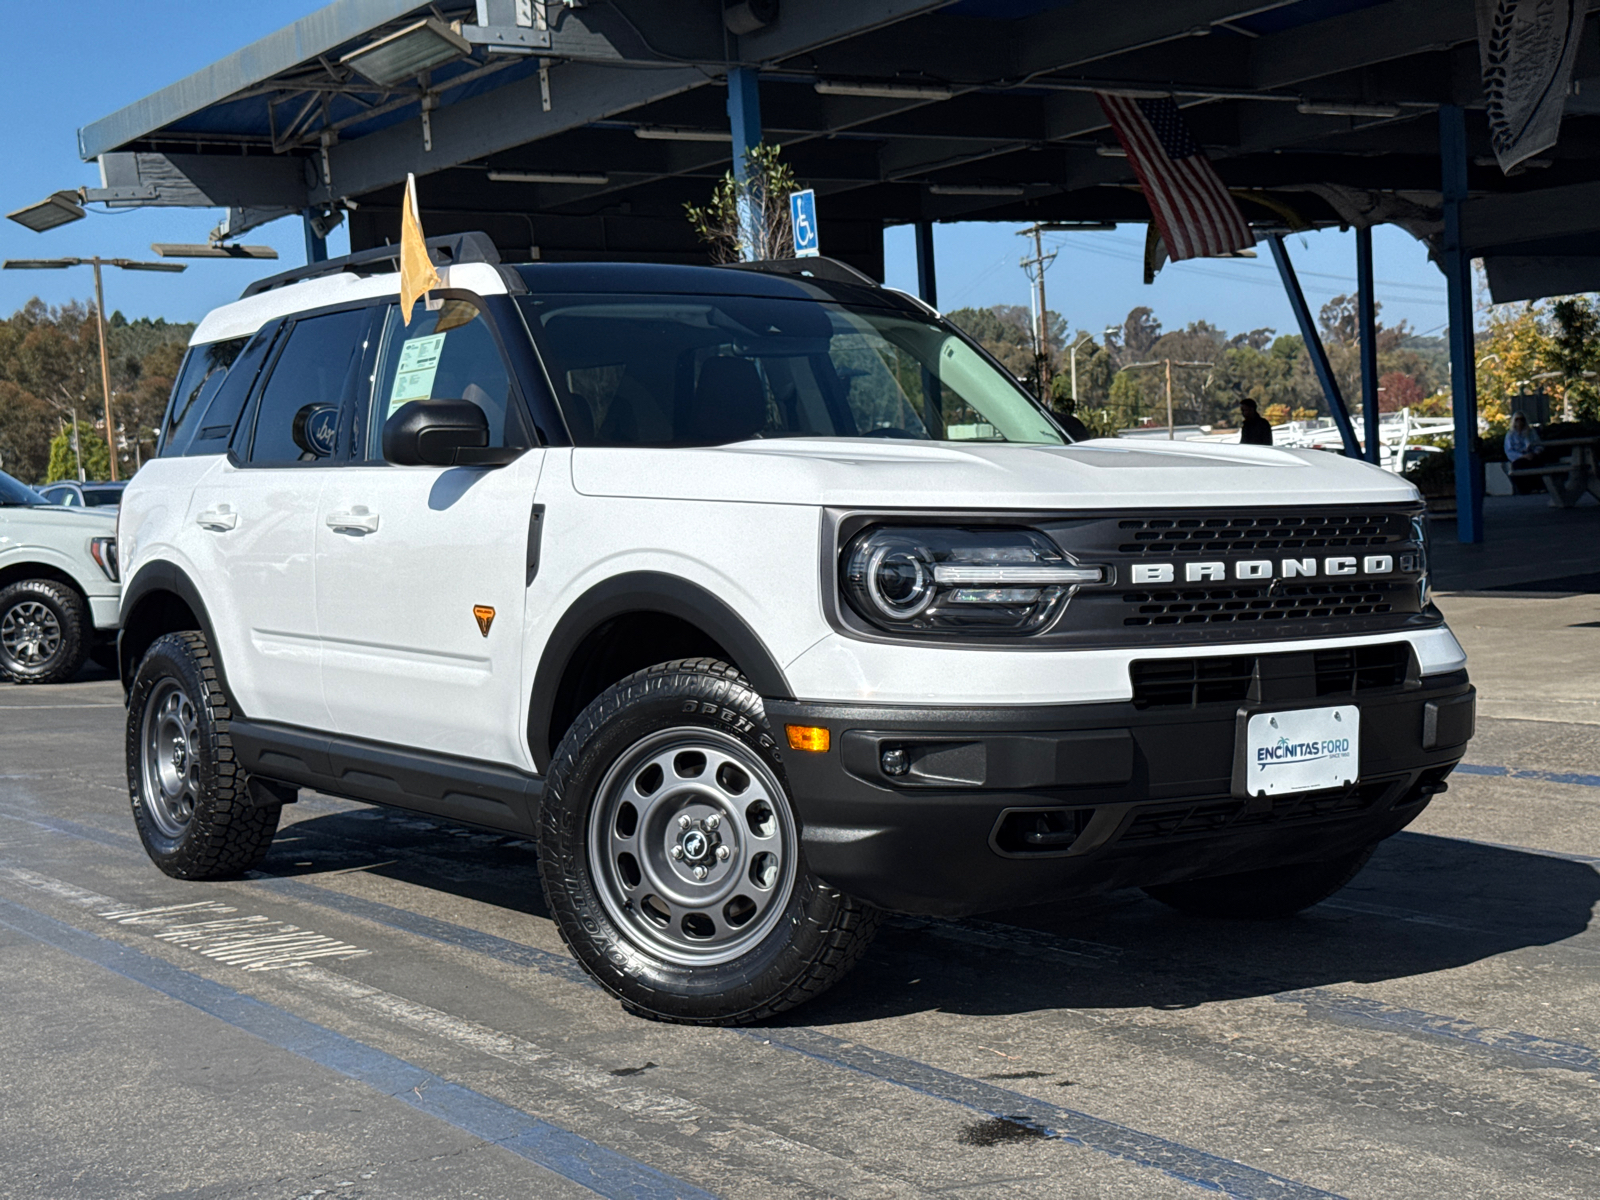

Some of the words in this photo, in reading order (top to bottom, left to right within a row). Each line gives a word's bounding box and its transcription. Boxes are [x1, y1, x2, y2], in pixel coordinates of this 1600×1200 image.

[1131, 555, 1393, 584] BRONCO
[682, 699, 755, 732] OPEN
[1257, 741, 1319, 761] ENCINITAS
[1321, 738, 1349, 754] FORD
[560, 808, 587, 911] TIRES
[580, 914, 643, 978] TOYO
